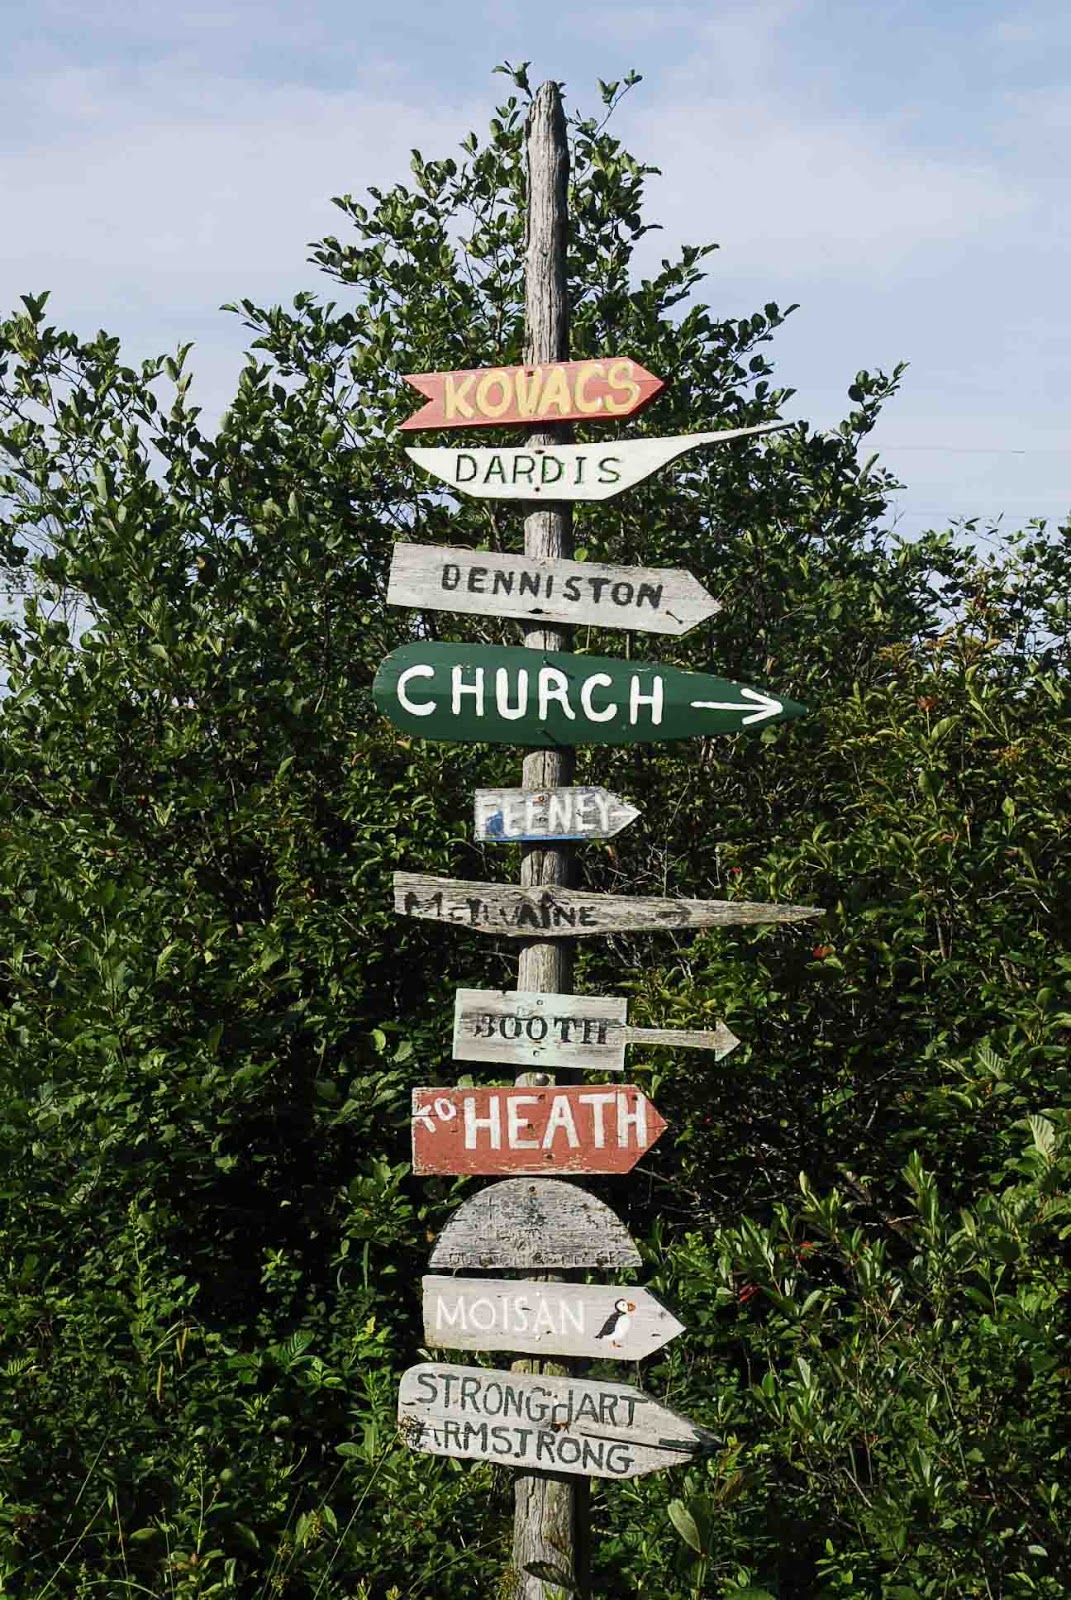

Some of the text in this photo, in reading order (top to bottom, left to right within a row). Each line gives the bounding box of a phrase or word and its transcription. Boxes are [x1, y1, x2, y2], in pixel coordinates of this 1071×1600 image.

[443, 361, 641, 421] KOVACS
[456, 455, 621, 484] DARDIS
[441, 563, 664, 609] DENNISTON
[397, 665, 664, 726] CHURCH
[475, 1013, 609, 1045] BOOTH
[464, 1092, 648, 1150] HEATH
[435, 1294, 587, 1335] MOISAN
